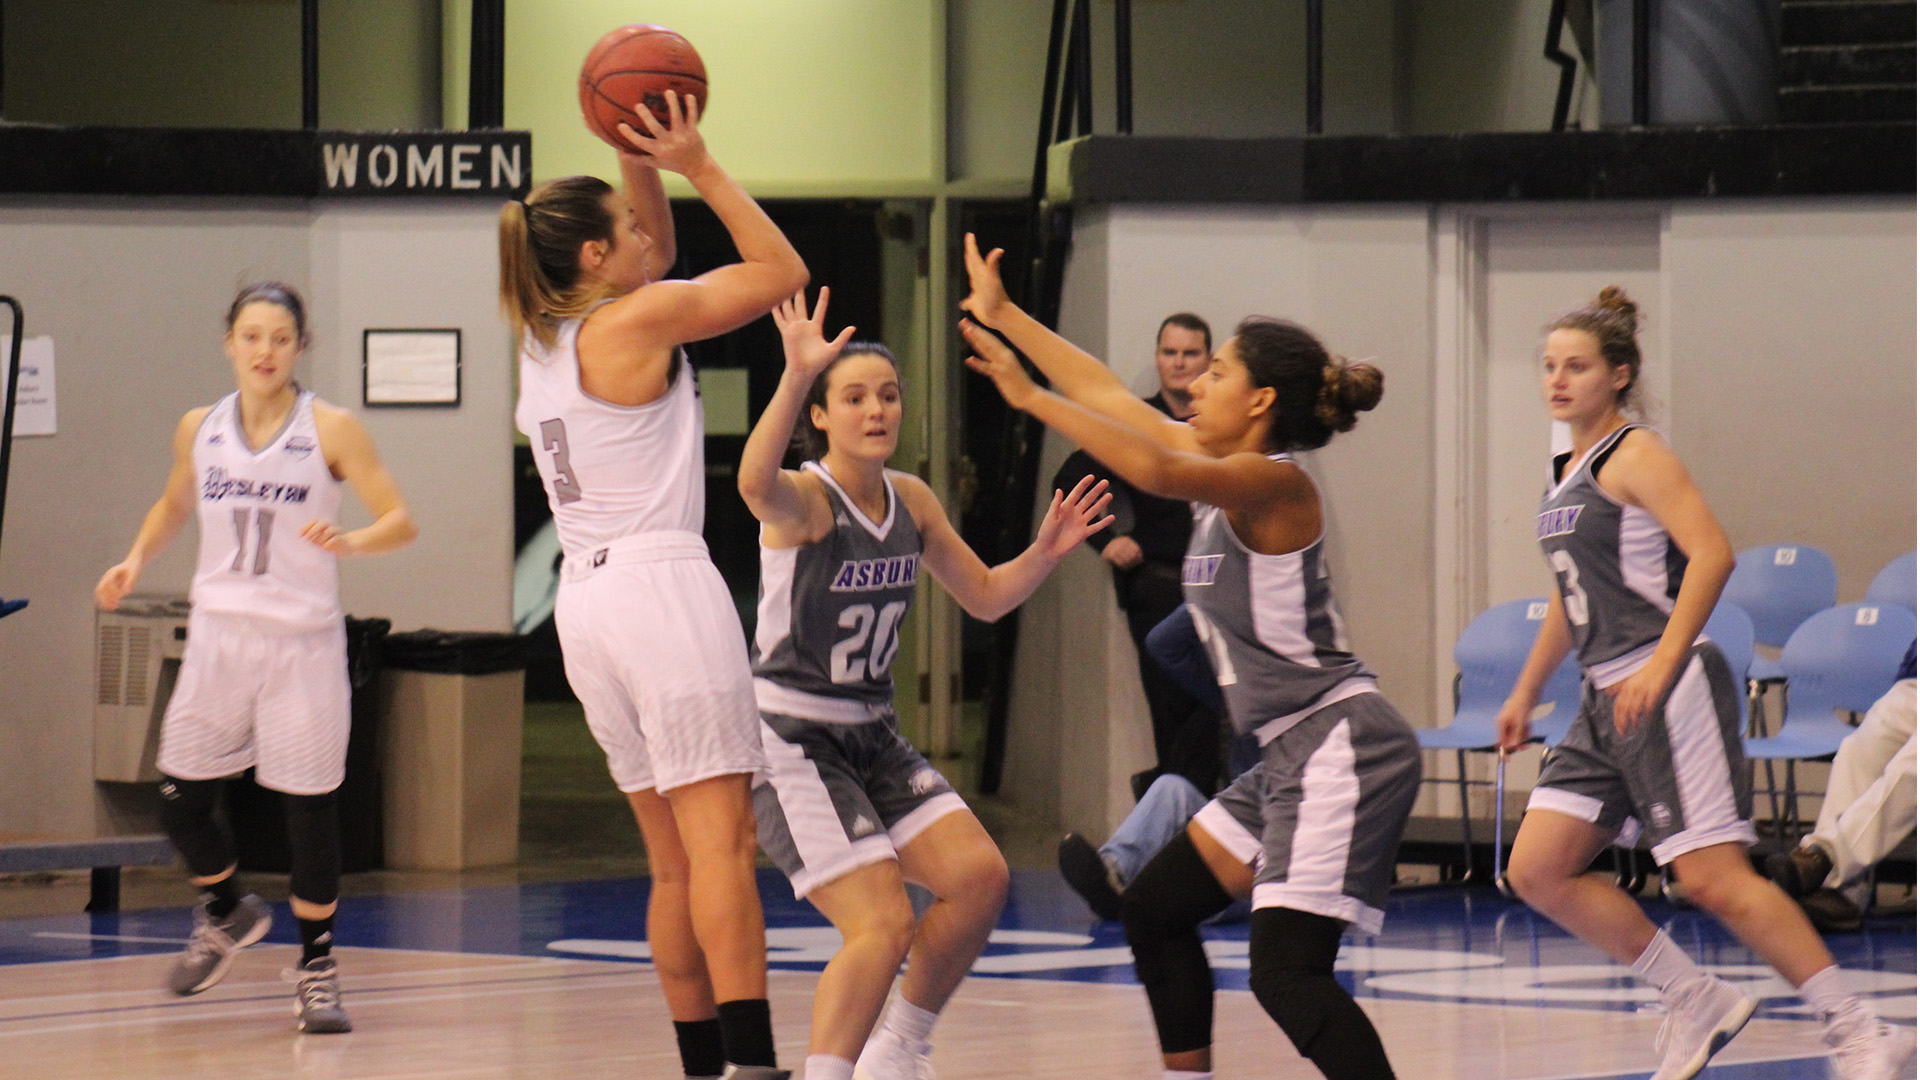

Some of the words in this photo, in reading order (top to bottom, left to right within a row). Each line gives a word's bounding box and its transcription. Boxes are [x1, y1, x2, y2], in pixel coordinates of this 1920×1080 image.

[322, 143, 521, 189] WOMEN
[540, 417, 582, 506] 3
[231, 506, 276, 576] 11
[829, 552, 920, 592] ASBUR
[830, 600, 907, 684] 20
